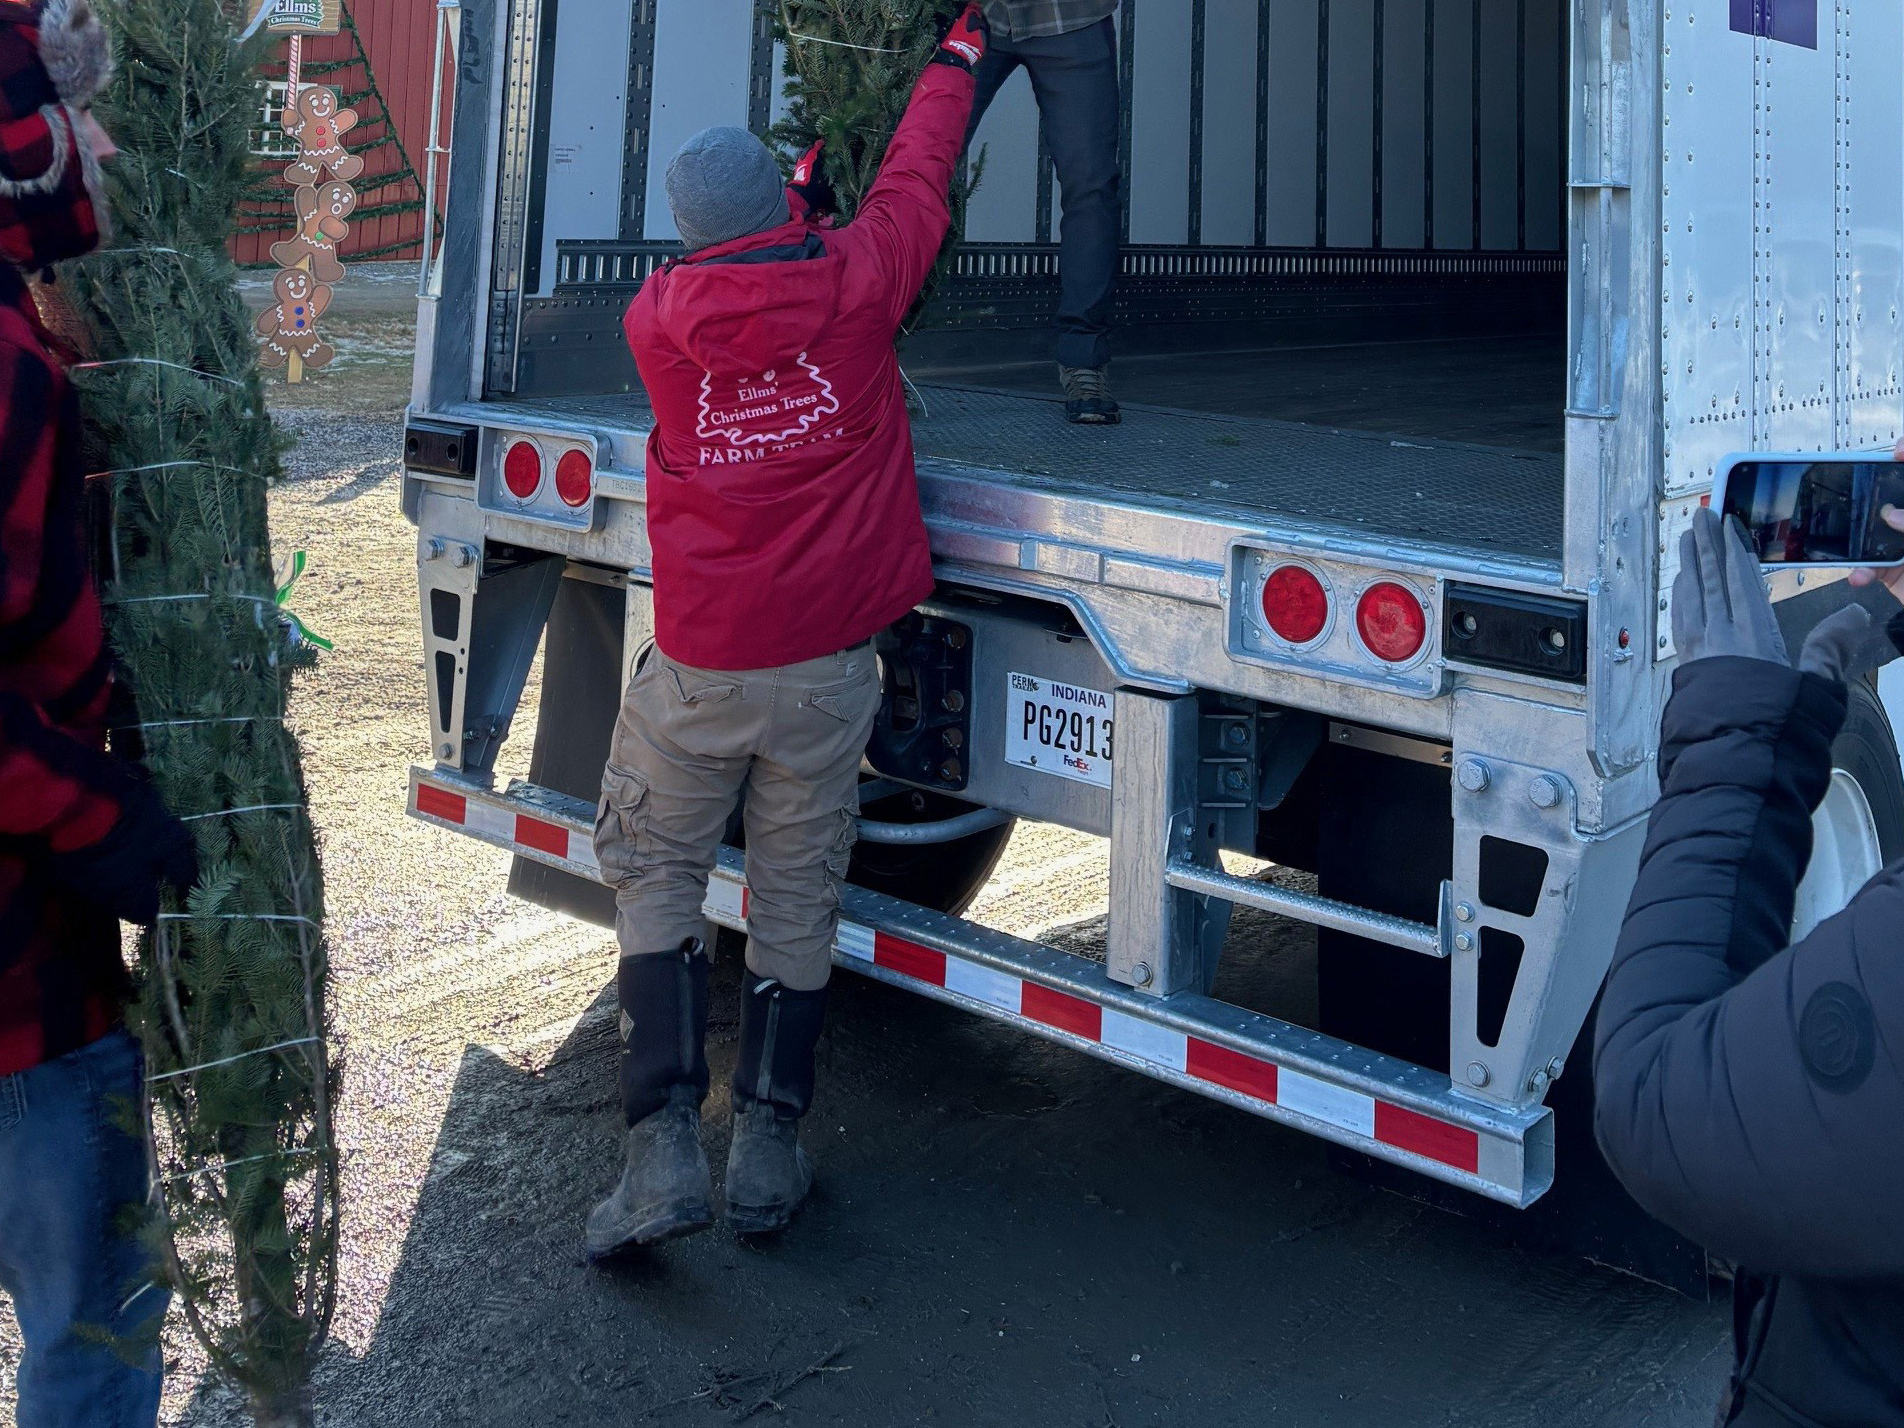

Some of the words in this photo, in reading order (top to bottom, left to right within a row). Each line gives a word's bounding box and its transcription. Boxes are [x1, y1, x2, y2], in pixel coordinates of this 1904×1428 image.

[301, 17, 317, 25] Trees
[737, 381, 779, 402] Ellms'
[710, 403, 778, 426] Christmas
[780, 393, 818, 411] Trees
[699, 446, 765, 466] FARM
[1012, 674, 1034, 689] PERM
[1051, 683, 1107, 709] INDIANA
[1023, 700, 1114, 761] PG2913
[1063, 754, 1090, 771] FedEx
